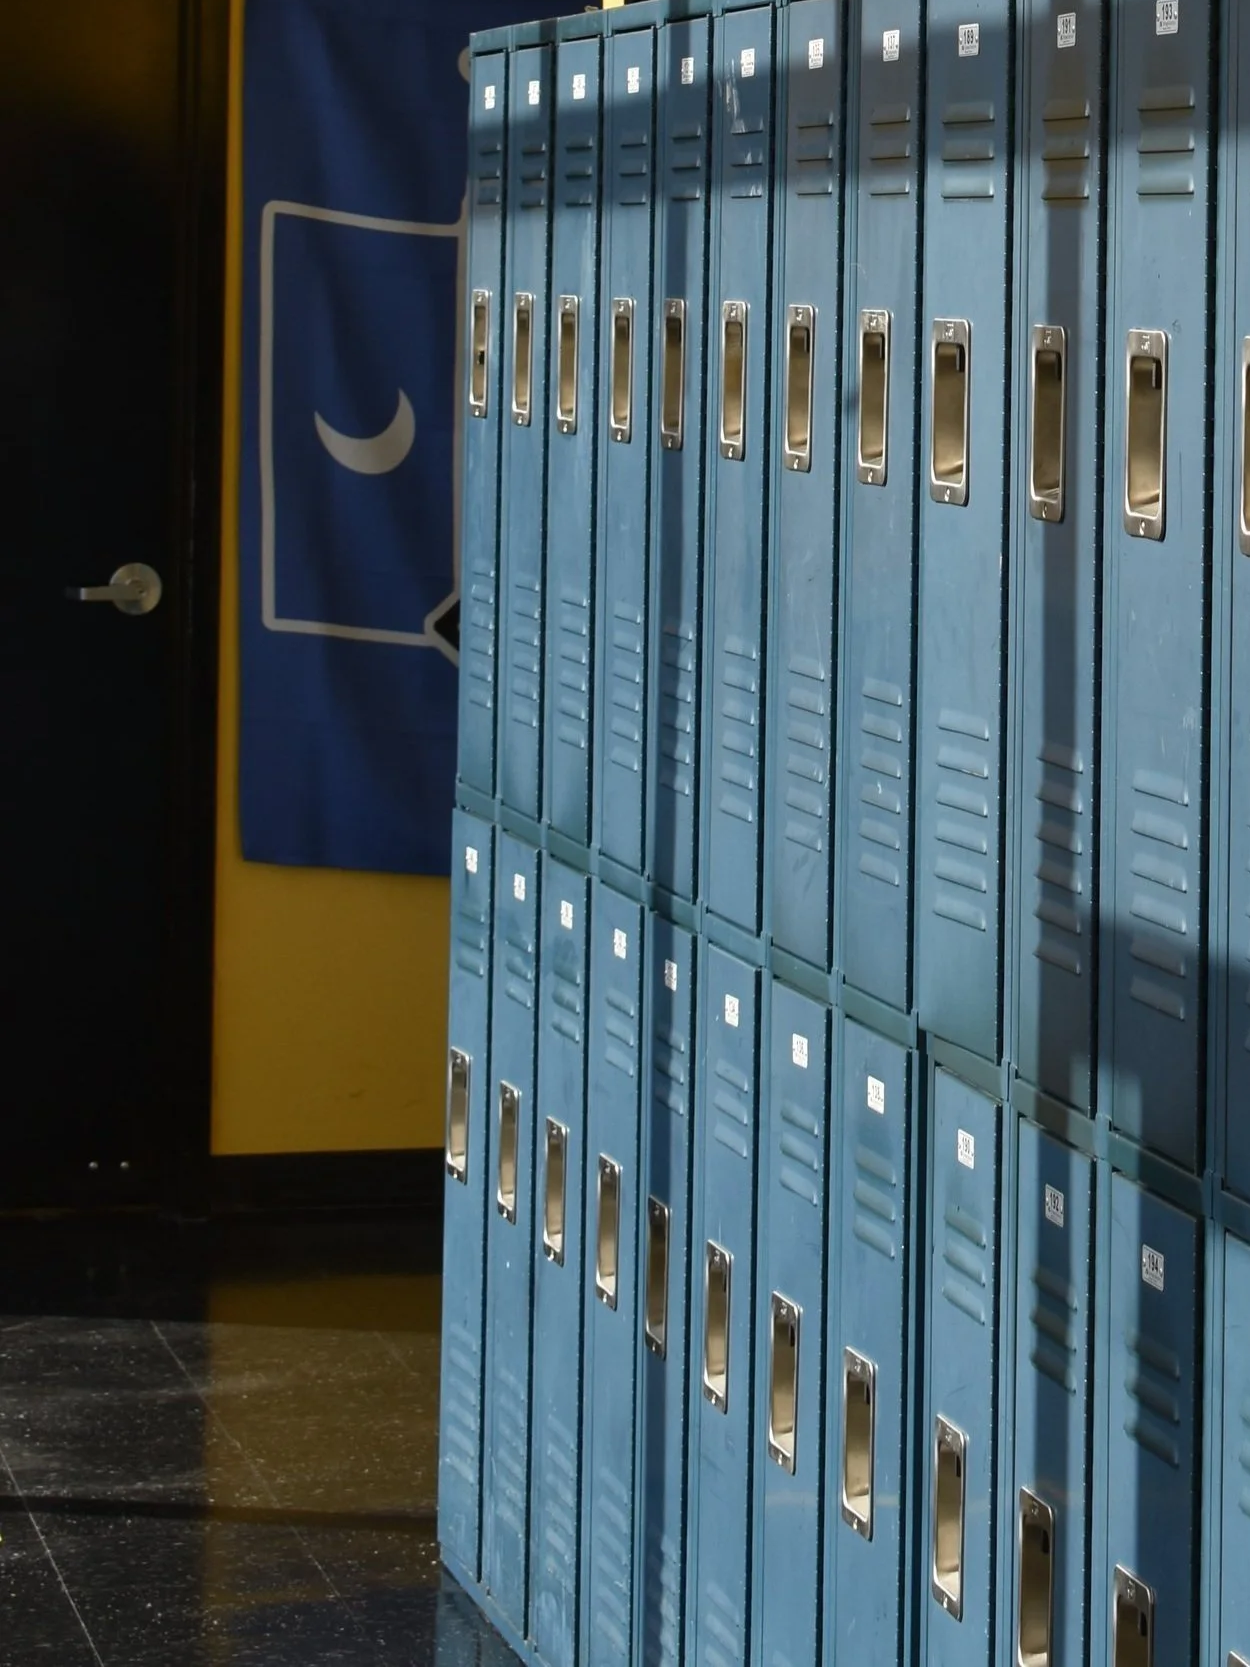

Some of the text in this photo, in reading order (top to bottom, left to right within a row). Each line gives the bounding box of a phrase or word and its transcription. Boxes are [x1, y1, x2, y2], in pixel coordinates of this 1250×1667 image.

[1161, 3, 1173, 21] 193
[1050, 1192, 1060, 1212] 192
[1148, 1252, 1159, 1272] 194
